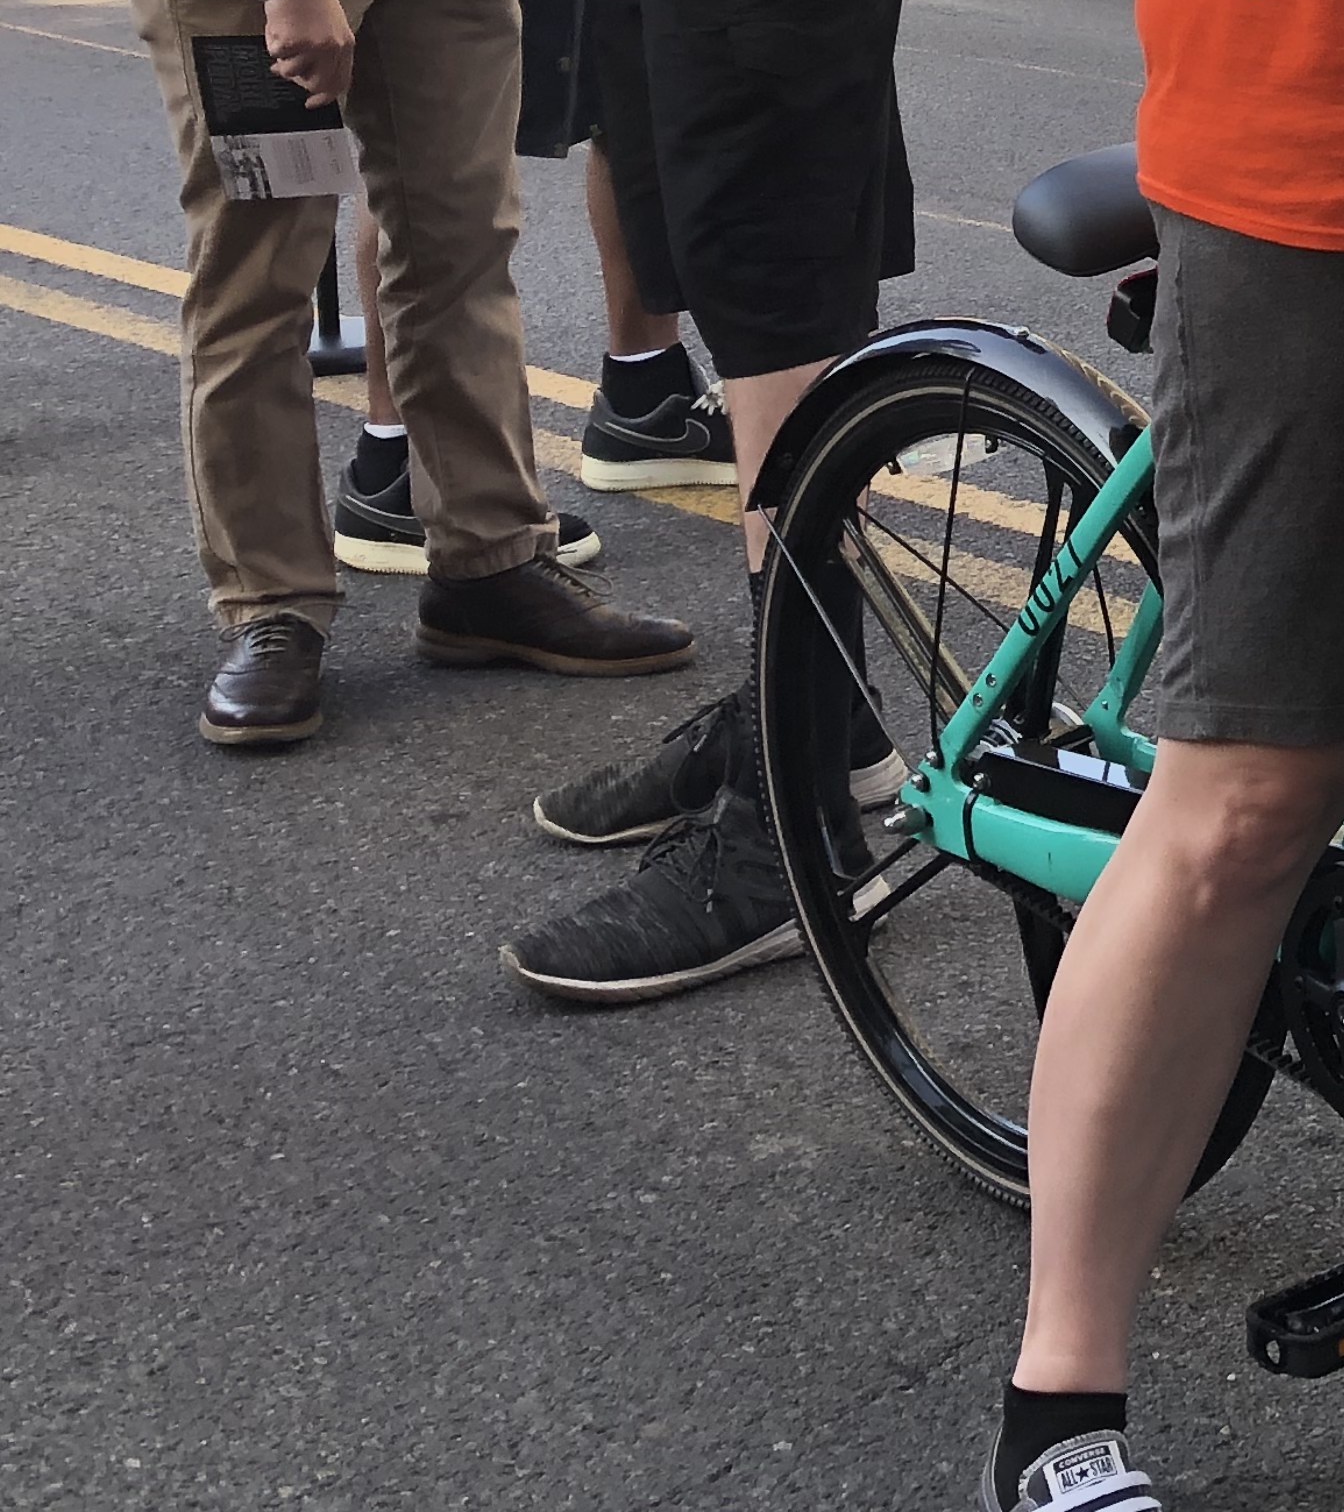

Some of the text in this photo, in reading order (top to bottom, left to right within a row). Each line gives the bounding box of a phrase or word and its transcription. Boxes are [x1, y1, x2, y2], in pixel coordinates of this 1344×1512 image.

[1058, 1447, 1106, 1469] CONVERSE
[1060, 1457, 1114, 1488] ALL STAR
